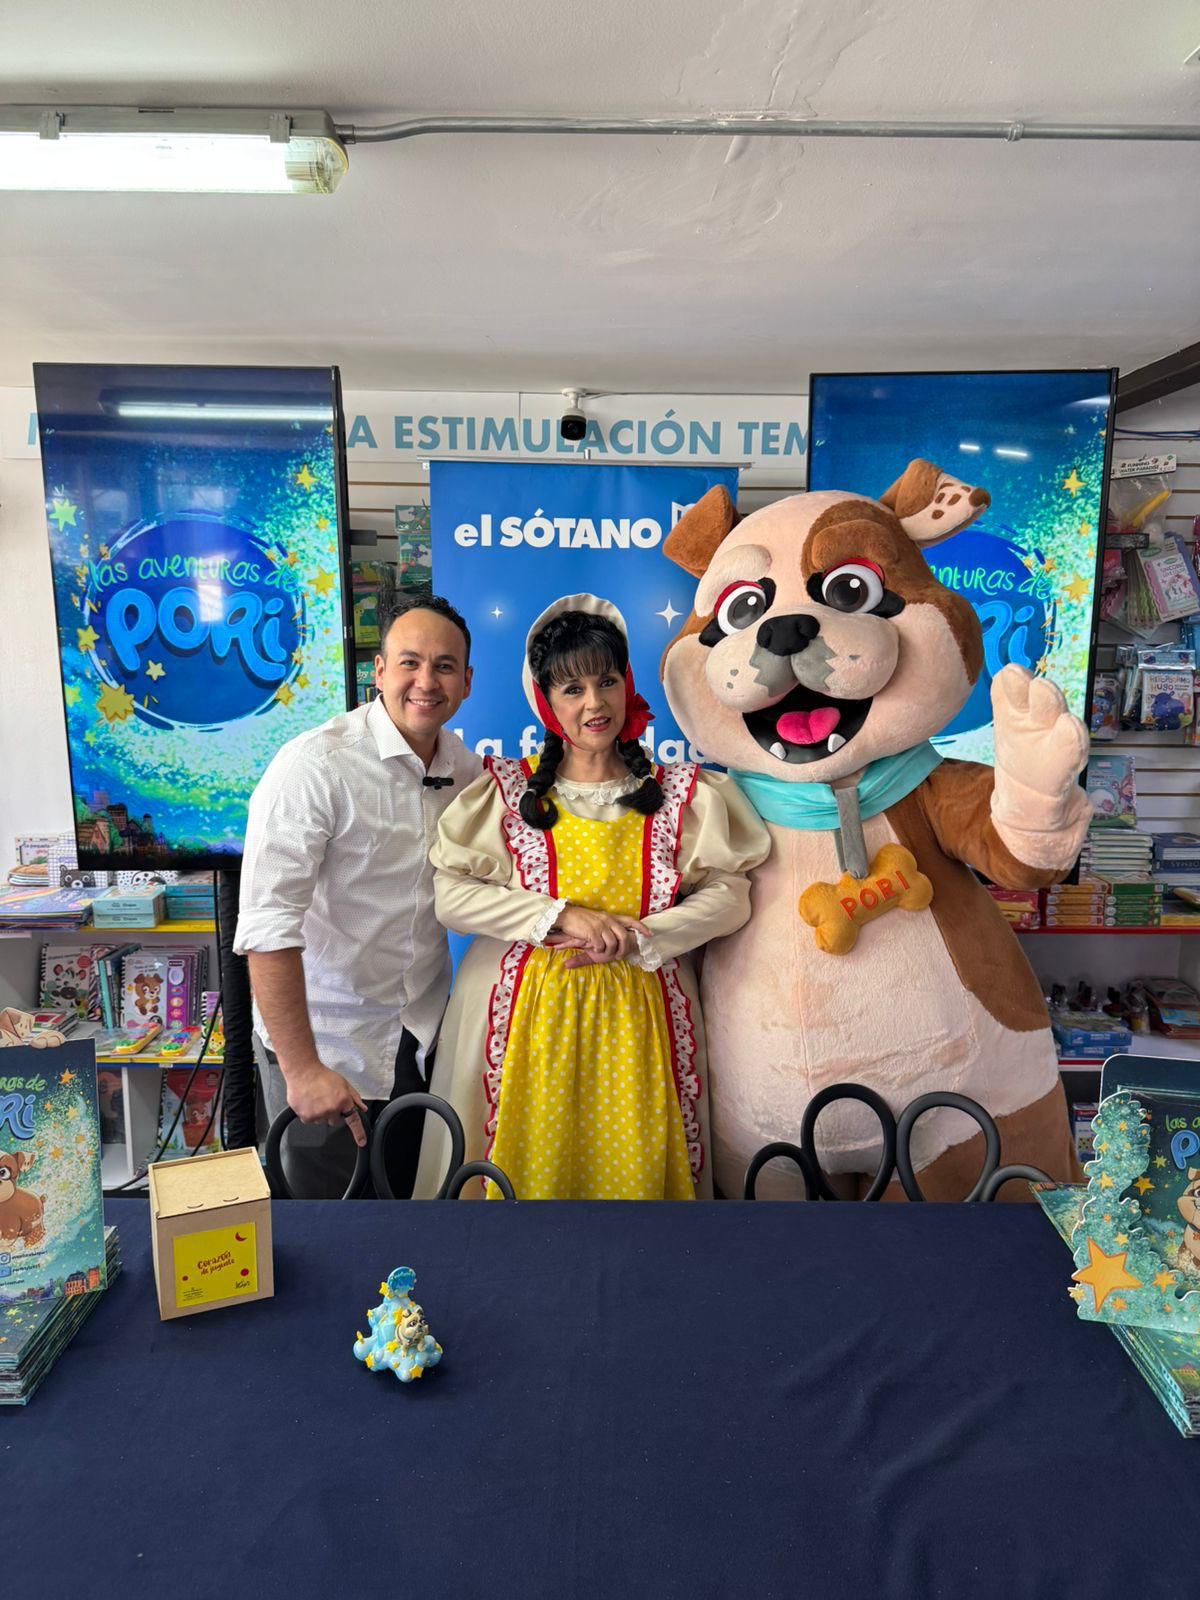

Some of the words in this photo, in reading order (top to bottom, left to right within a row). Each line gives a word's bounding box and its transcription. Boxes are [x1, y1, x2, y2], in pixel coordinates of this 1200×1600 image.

[395, 409, 721, 455] ESTIMULACIÓN
[454, 513, 492, 547] el
[500, 507, 662, 549] SÓTANO
[88, 560, 128, 592] las
[263, 563, 299, 593] de
[1018, 570, 1052, 600] de
[839, 870, 911, 921] PORI
[25, 1073, 48, 1092] de
[1165, 1114, 1188, 1132] las
